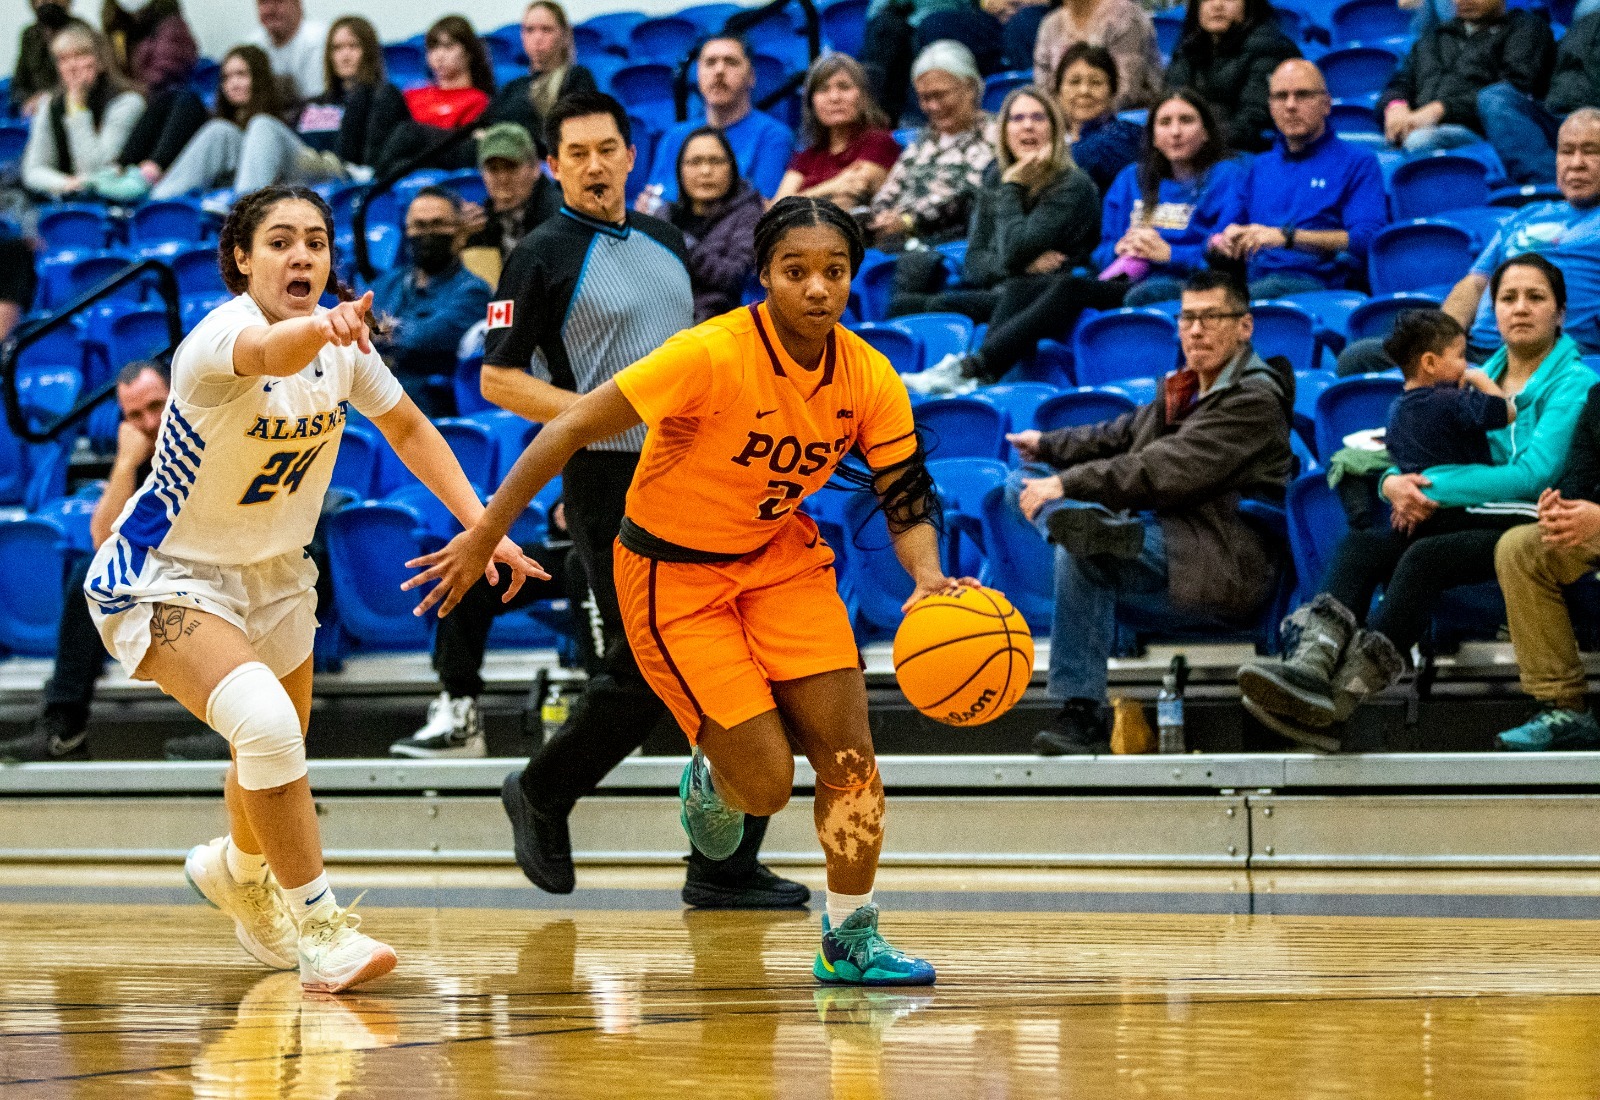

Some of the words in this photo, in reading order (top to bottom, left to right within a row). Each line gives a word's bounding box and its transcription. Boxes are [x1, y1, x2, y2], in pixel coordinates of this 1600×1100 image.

[245, 399, 349, 440] ALASKA
[238, 439, 330, 505] 24
[753, 479, 806, 520] 2
[942, 688, 998, 723] lson
